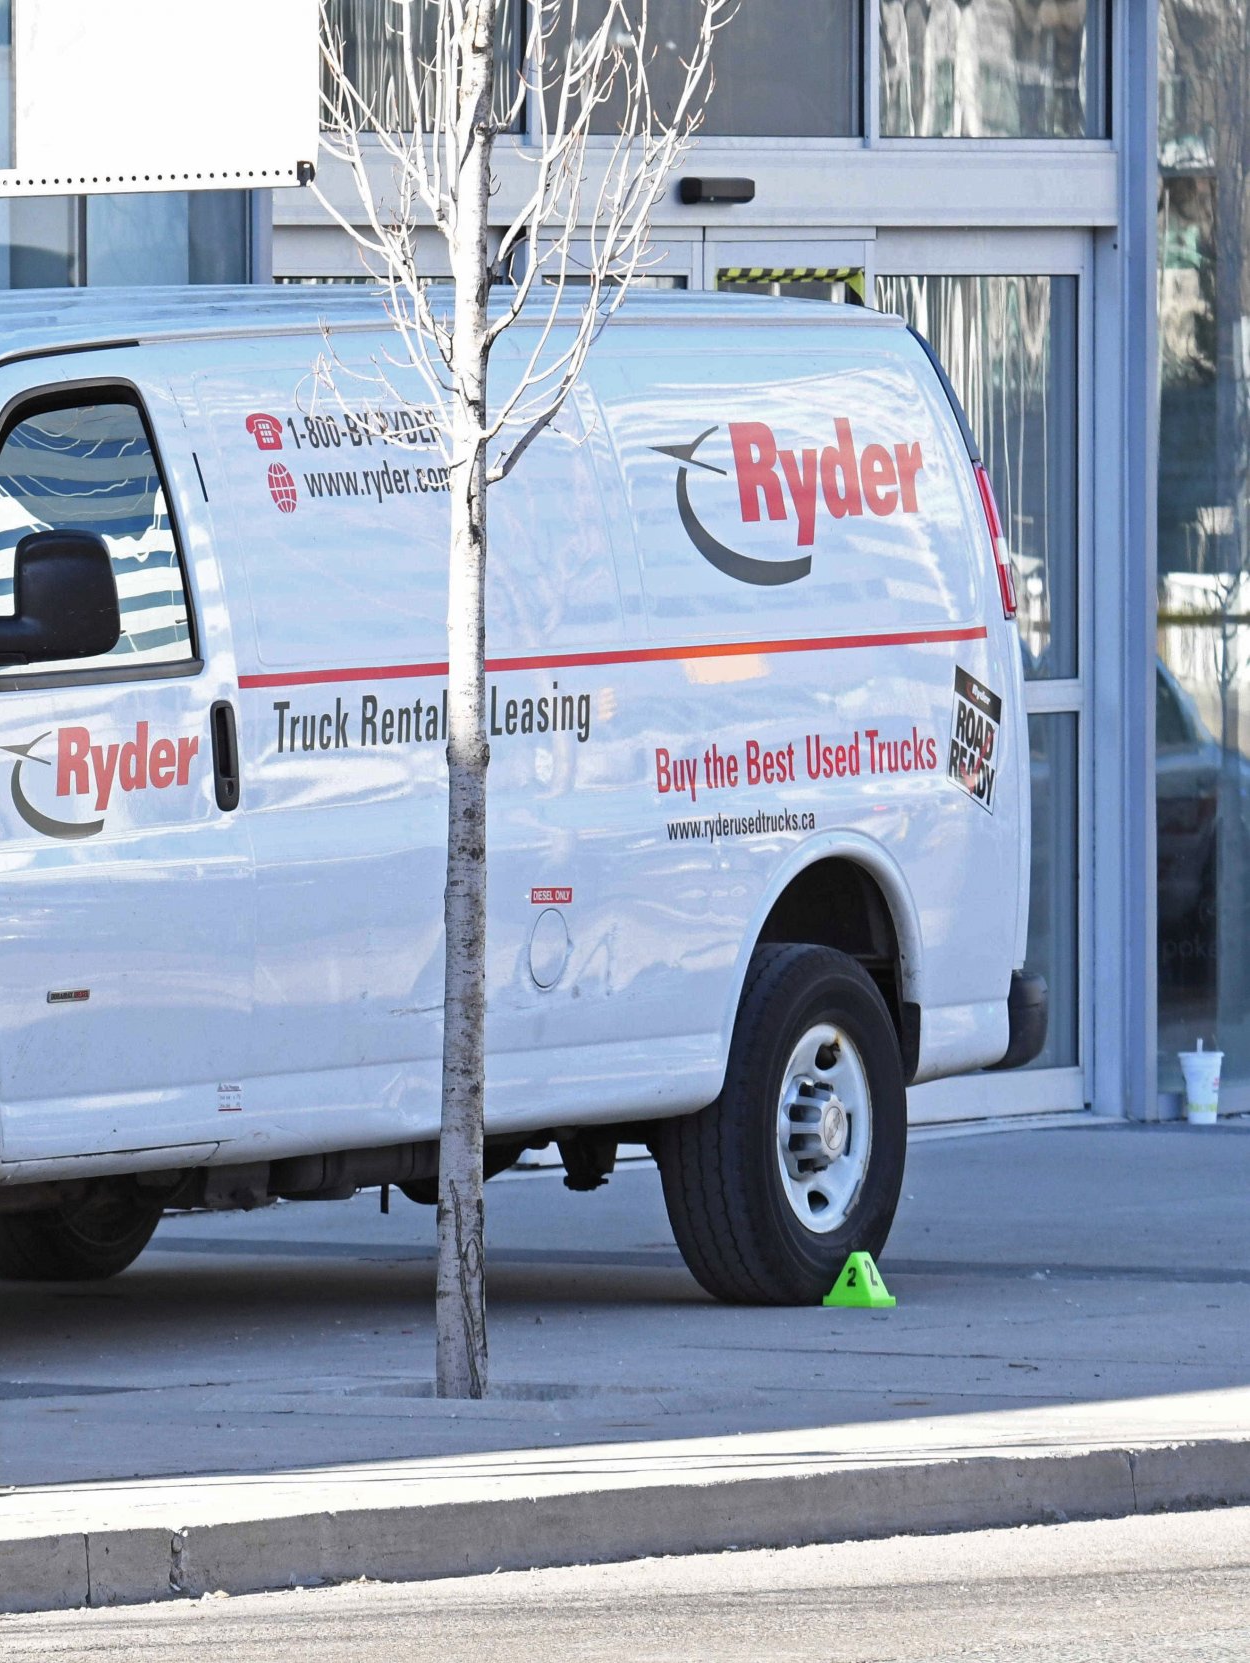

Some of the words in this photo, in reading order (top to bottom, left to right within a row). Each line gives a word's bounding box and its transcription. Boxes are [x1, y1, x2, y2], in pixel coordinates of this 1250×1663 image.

[304, 460, 451, 503] www.ryder.com
[728, 417, 924, 547] Ryder
[273, 698, 350, 753] Truck
[361, 690, 448, 747] Rental
[490, 682, 591, 743] Leasing
[956, 699, 996, 762] ROAD
[56, 721, 199, 811] Ryder
[655, 747, 698, 802] Buy
[703, 743, 739, 789] the
[745, 740, 795, 786] Best
[805, 731, 861, 780] Used
[864, 726, 938, 774] Trucks
[949, 738, 995, 806] READY
[666, 808, 816, 844] www.ryderusedtrucks.ca
[533, 890, 553, 901] DIESEL
[555, 890, 570, 900] ONLY
[846, 1267, 857, 1287] 2
[864, 1260, 878, 1286] 2
